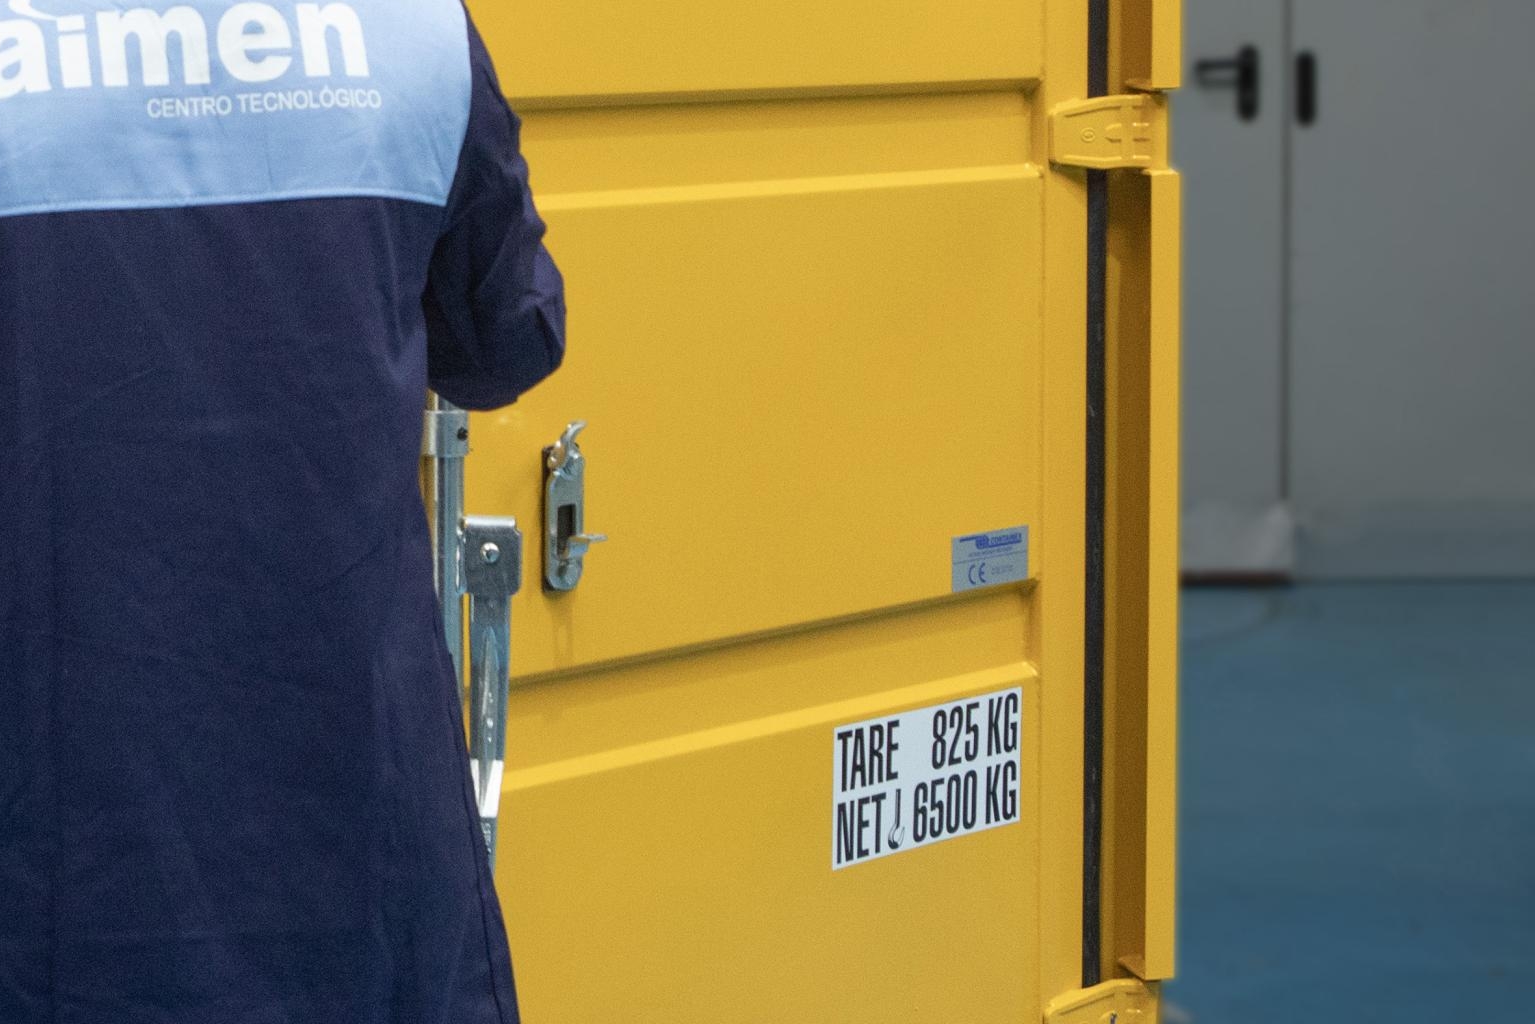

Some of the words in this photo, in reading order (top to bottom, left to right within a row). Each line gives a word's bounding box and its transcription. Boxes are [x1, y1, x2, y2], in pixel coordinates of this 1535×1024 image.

[147, 96, 232, 119] CENTRO
[236, 84, 382, 114] TECNOLÓGICO
[837, 719, 900, 792] TARE
[931, 701, 980, 770] 825
[986, 692, 1019, 757] KG
[837, 792, 887, 864] NET
[912, 769, 978, 843] 6500
[985, 759, 1017, 825] KG
